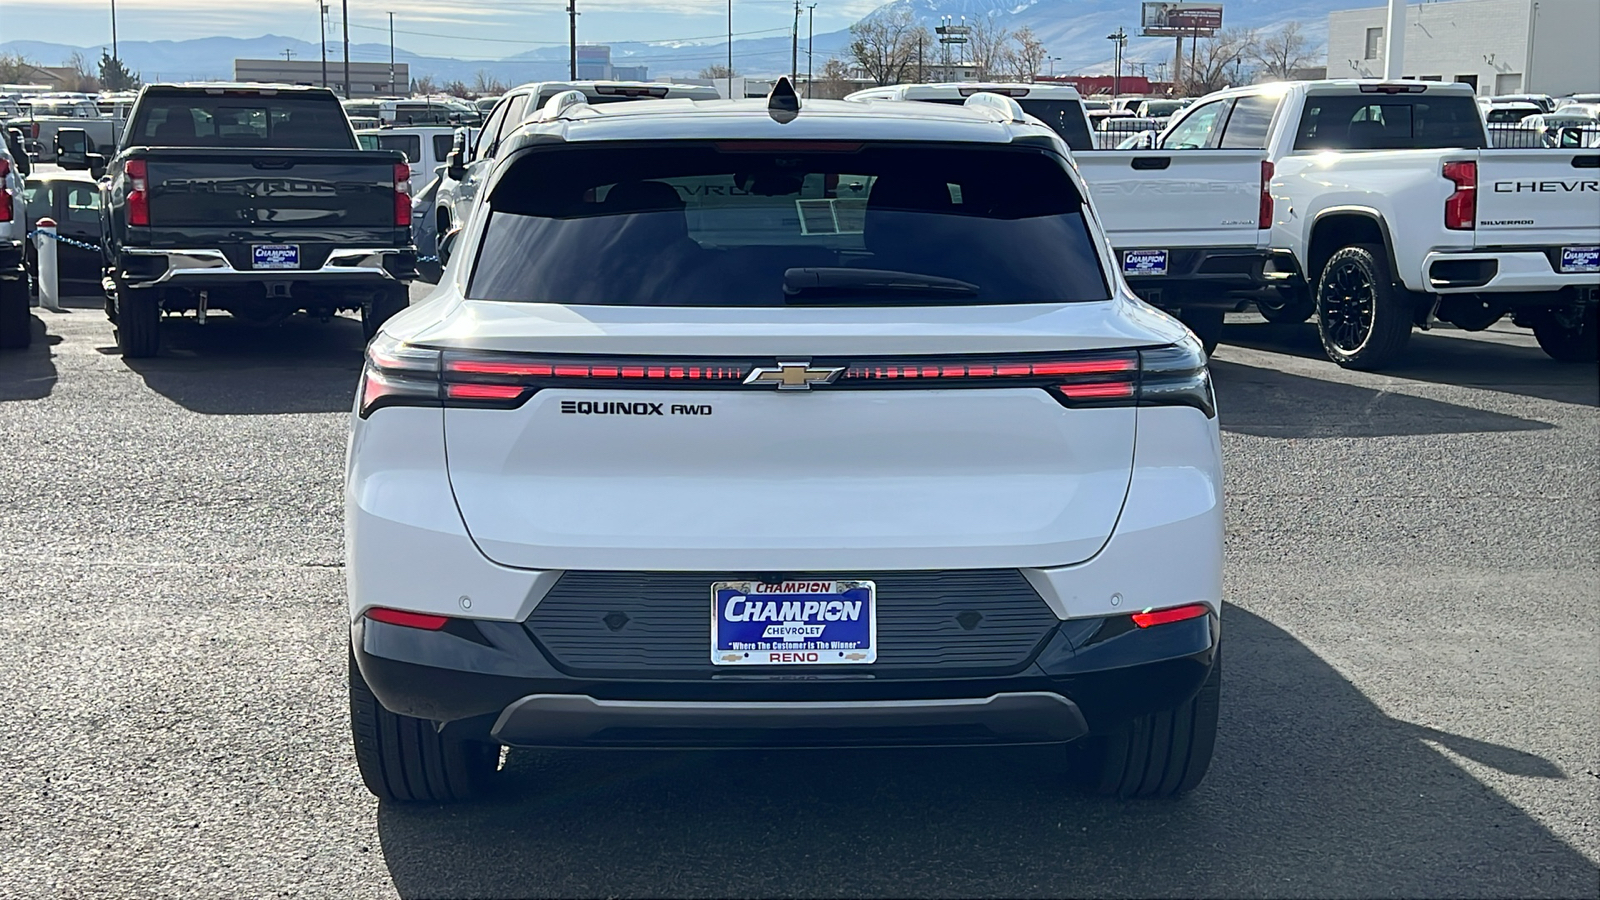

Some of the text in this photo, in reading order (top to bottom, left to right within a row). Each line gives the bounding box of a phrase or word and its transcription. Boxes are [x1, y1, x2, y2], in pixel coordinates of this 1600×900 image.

[255, 248, 296, 257] CHAMPION
[1563, 251, 1599, 260] CHAMPION
[1126, 254, 1165, 263] CHAMPION
[561, 401, 713, 416] EQUINOX AWD
[755, 582, 832, 593] CHAMPION
[724, 596, 862, 622] CHAMPION
[766, 626, 821, 636] CHEVROLET
[757, 641, 770, 650] The
[772, 641, 807, 650] Customer
[807, 641, 815, 650] Is
[816, 641, 830, 650] The
[769, 652, 819, 662] RENO
